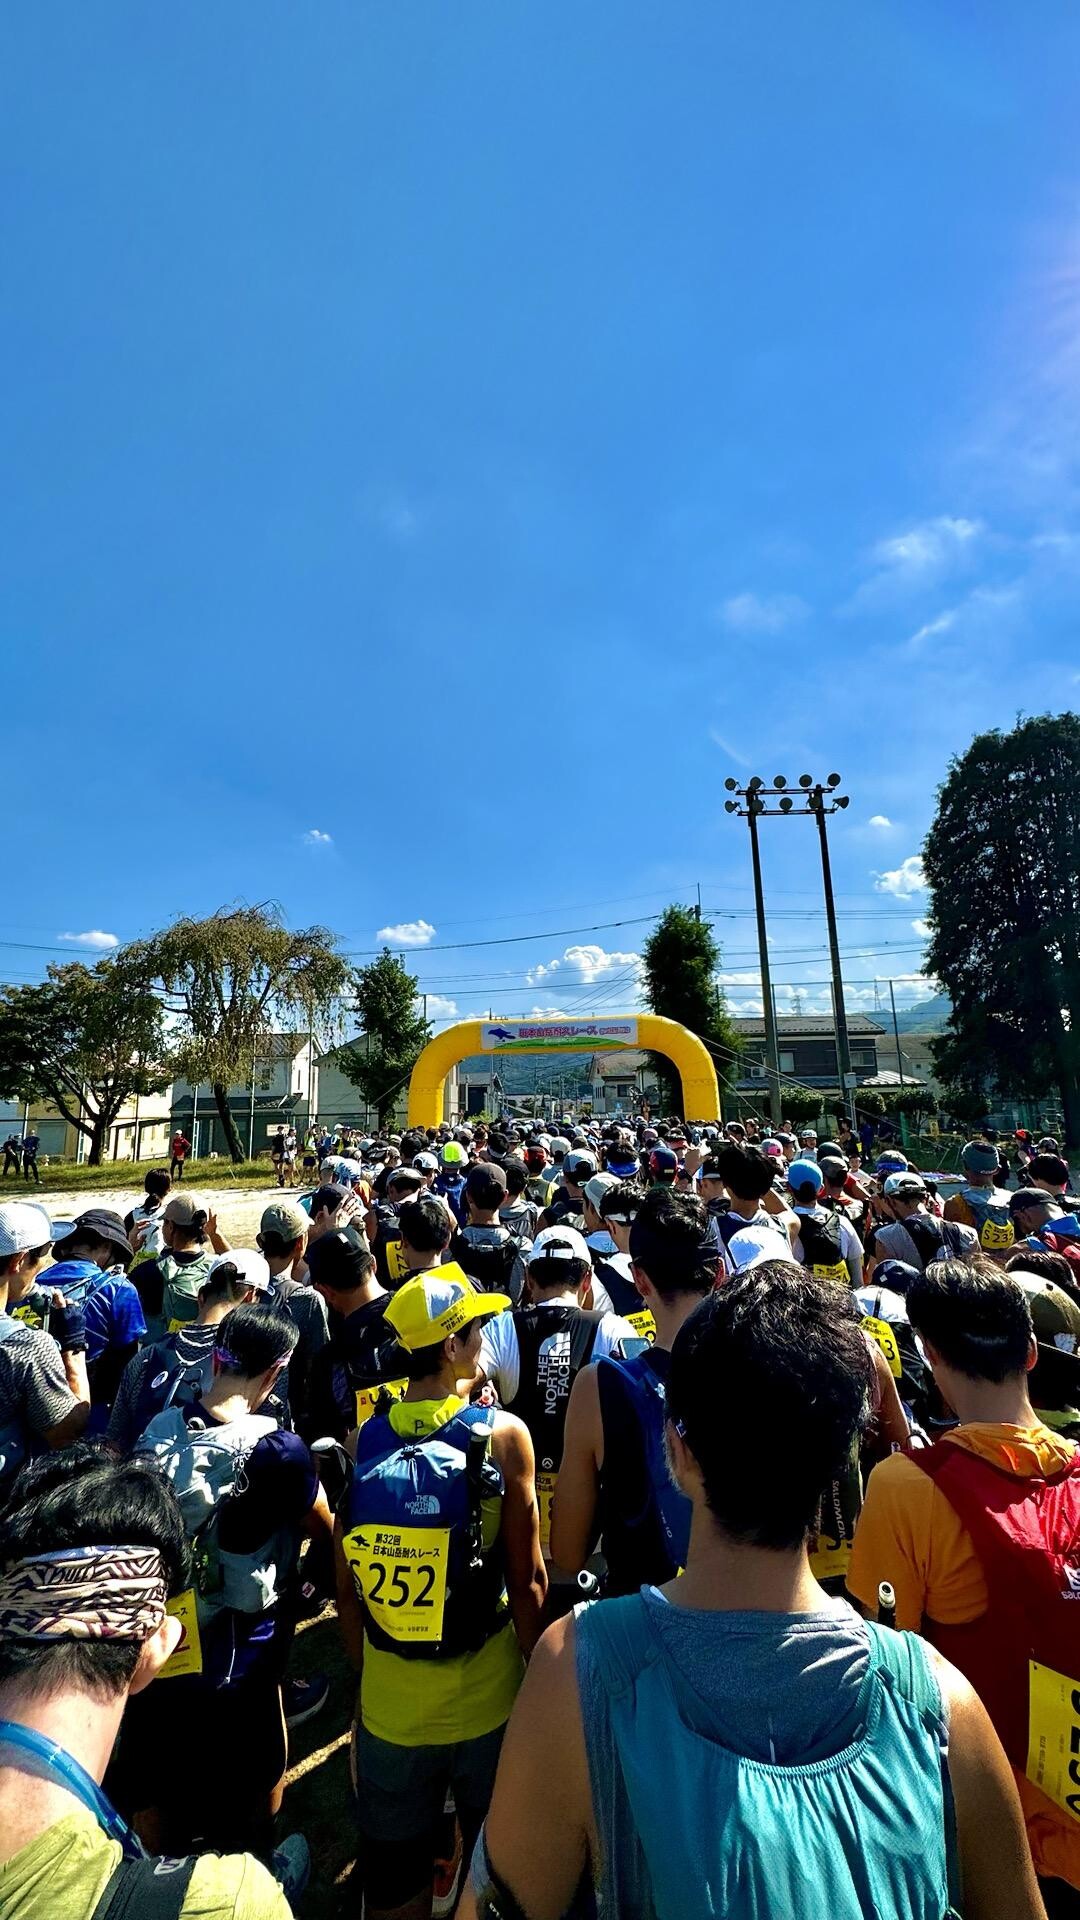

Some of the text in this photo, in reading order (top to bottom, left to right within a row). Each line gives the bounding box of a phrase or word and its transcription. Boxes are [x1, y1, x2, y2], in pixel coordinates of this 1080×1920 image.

[537, 1356, 548, 1385] THE
[558, 1356, 570, 1396] FACE
[545, 1356, 560, 1414] NORTH
[405, 1501, 430, 1509] NORTH
[416, 1494, 429, 1502] THE
[375, 1533, 402, 1546] 第32回
[372, 1545, 440, 1559] 日本山岳耐久レース
